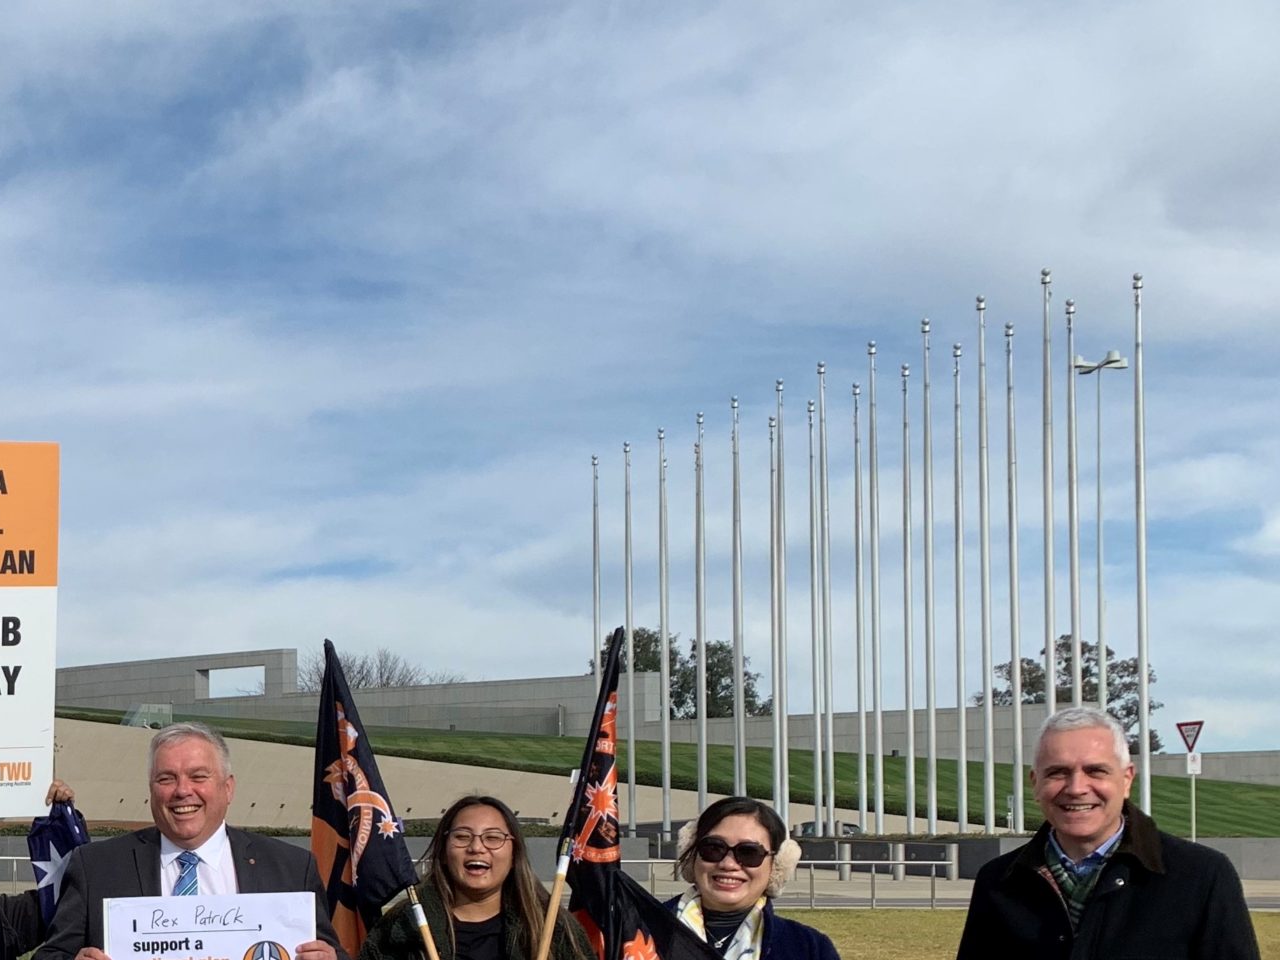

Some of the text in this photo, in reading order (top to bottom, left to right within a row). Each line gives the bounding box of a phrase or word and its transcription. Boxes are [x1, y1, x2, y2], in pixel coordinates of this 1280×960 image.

[132, 919, 137, 932] I
[150, 908, 179, 929] Rex
[194, 904, 244, 926] Patrick
[133, 937, 203, 954] support a
